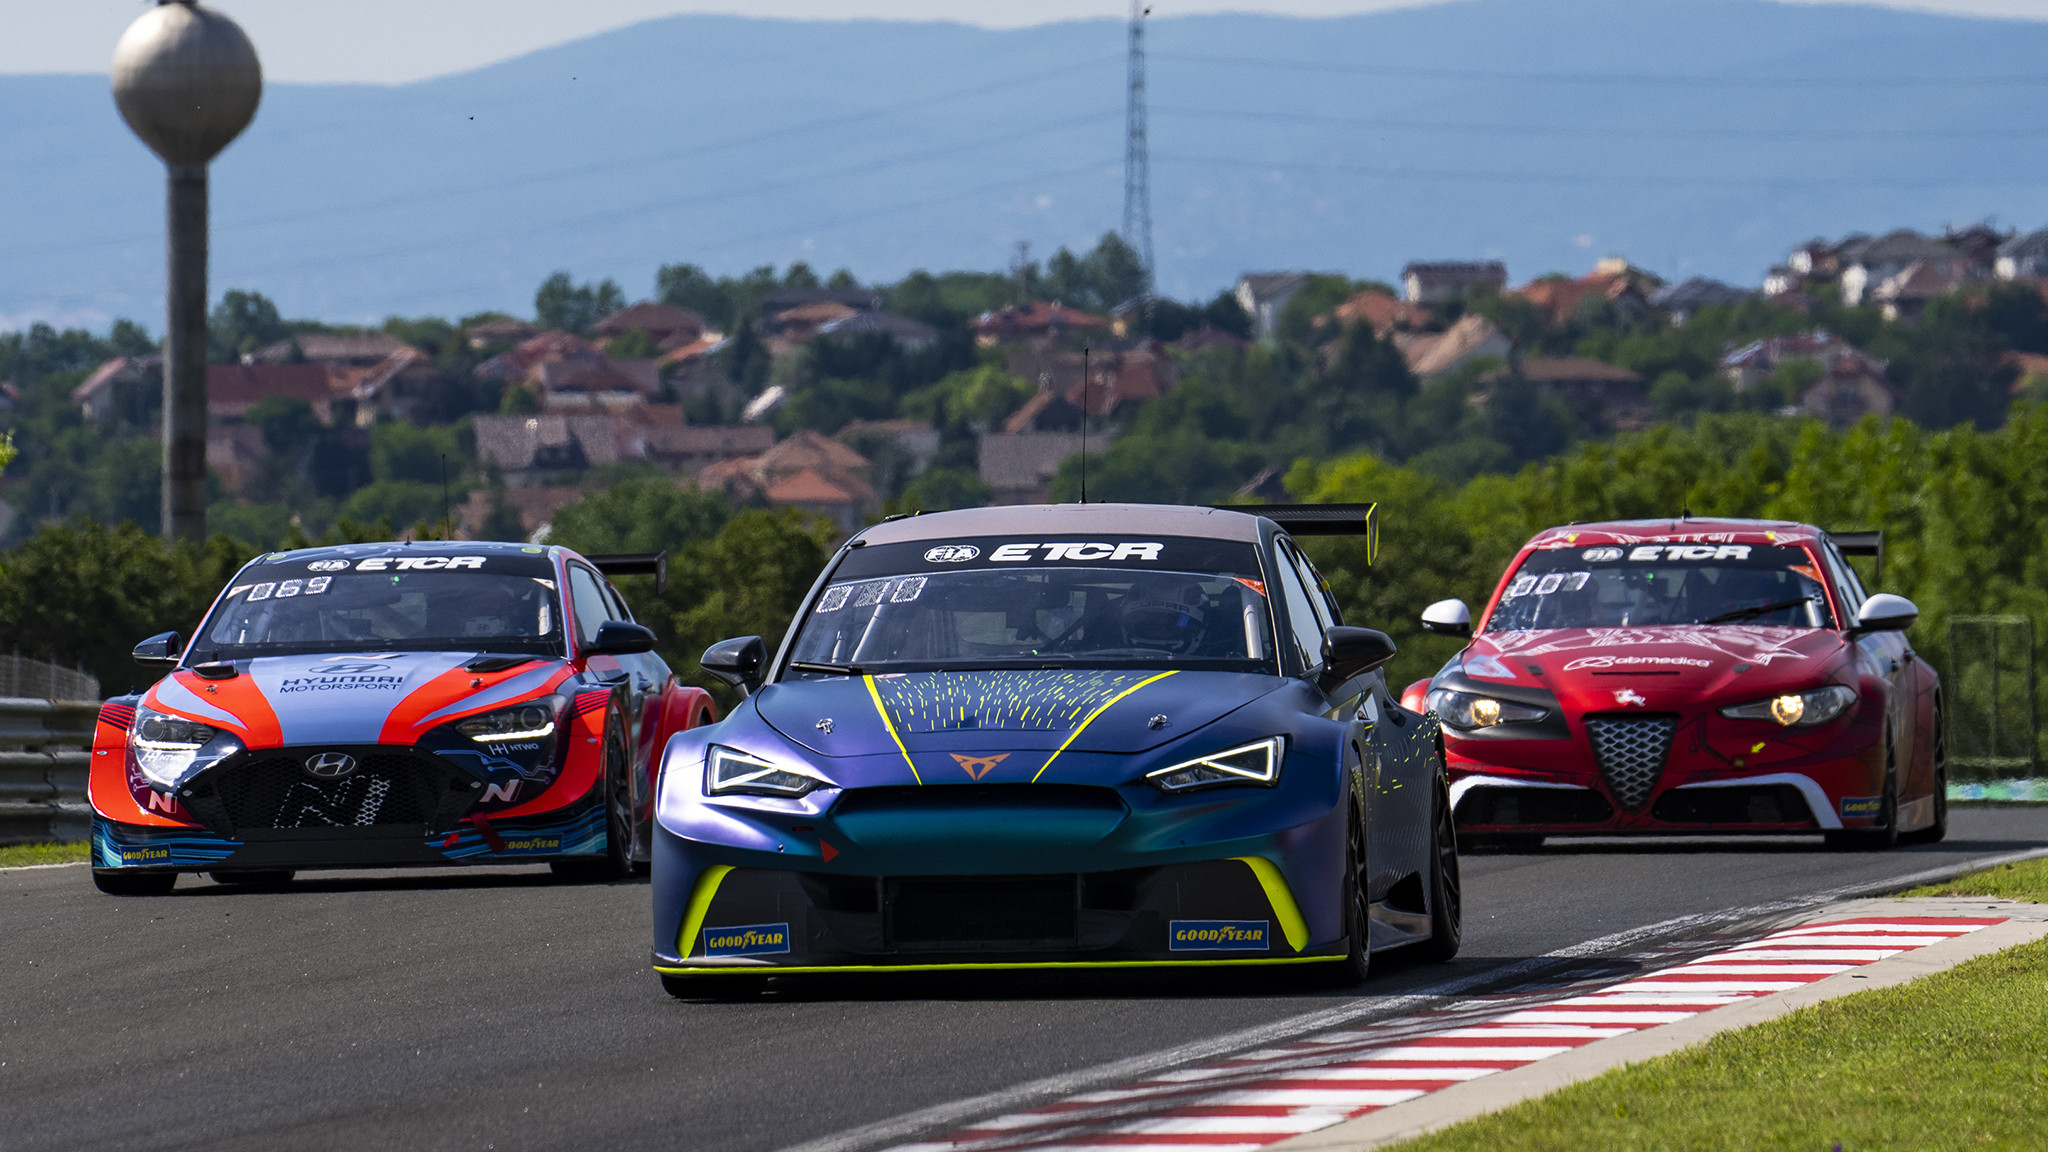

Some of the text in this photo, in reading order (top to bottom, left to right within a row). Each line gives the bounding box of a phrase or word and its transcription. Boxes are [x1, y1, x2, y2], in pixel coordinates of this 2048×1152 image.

[926, 543, 1164, 562] FIA ETCR
[1629, 546, 1752, 561] ETCR
[355, 556, 487, 571] ETCR
[246, 576, 332, 601] 069
[279, 683, 401, 693] MOTORSPORT
[282, 675, 403, 686] HYUNDAI
[123, 848, 167, 861] GOODYEAR
[709, 931, 783, 949] GOODYEAR
[1176, 926, 1263, 944] GOODYEAR
